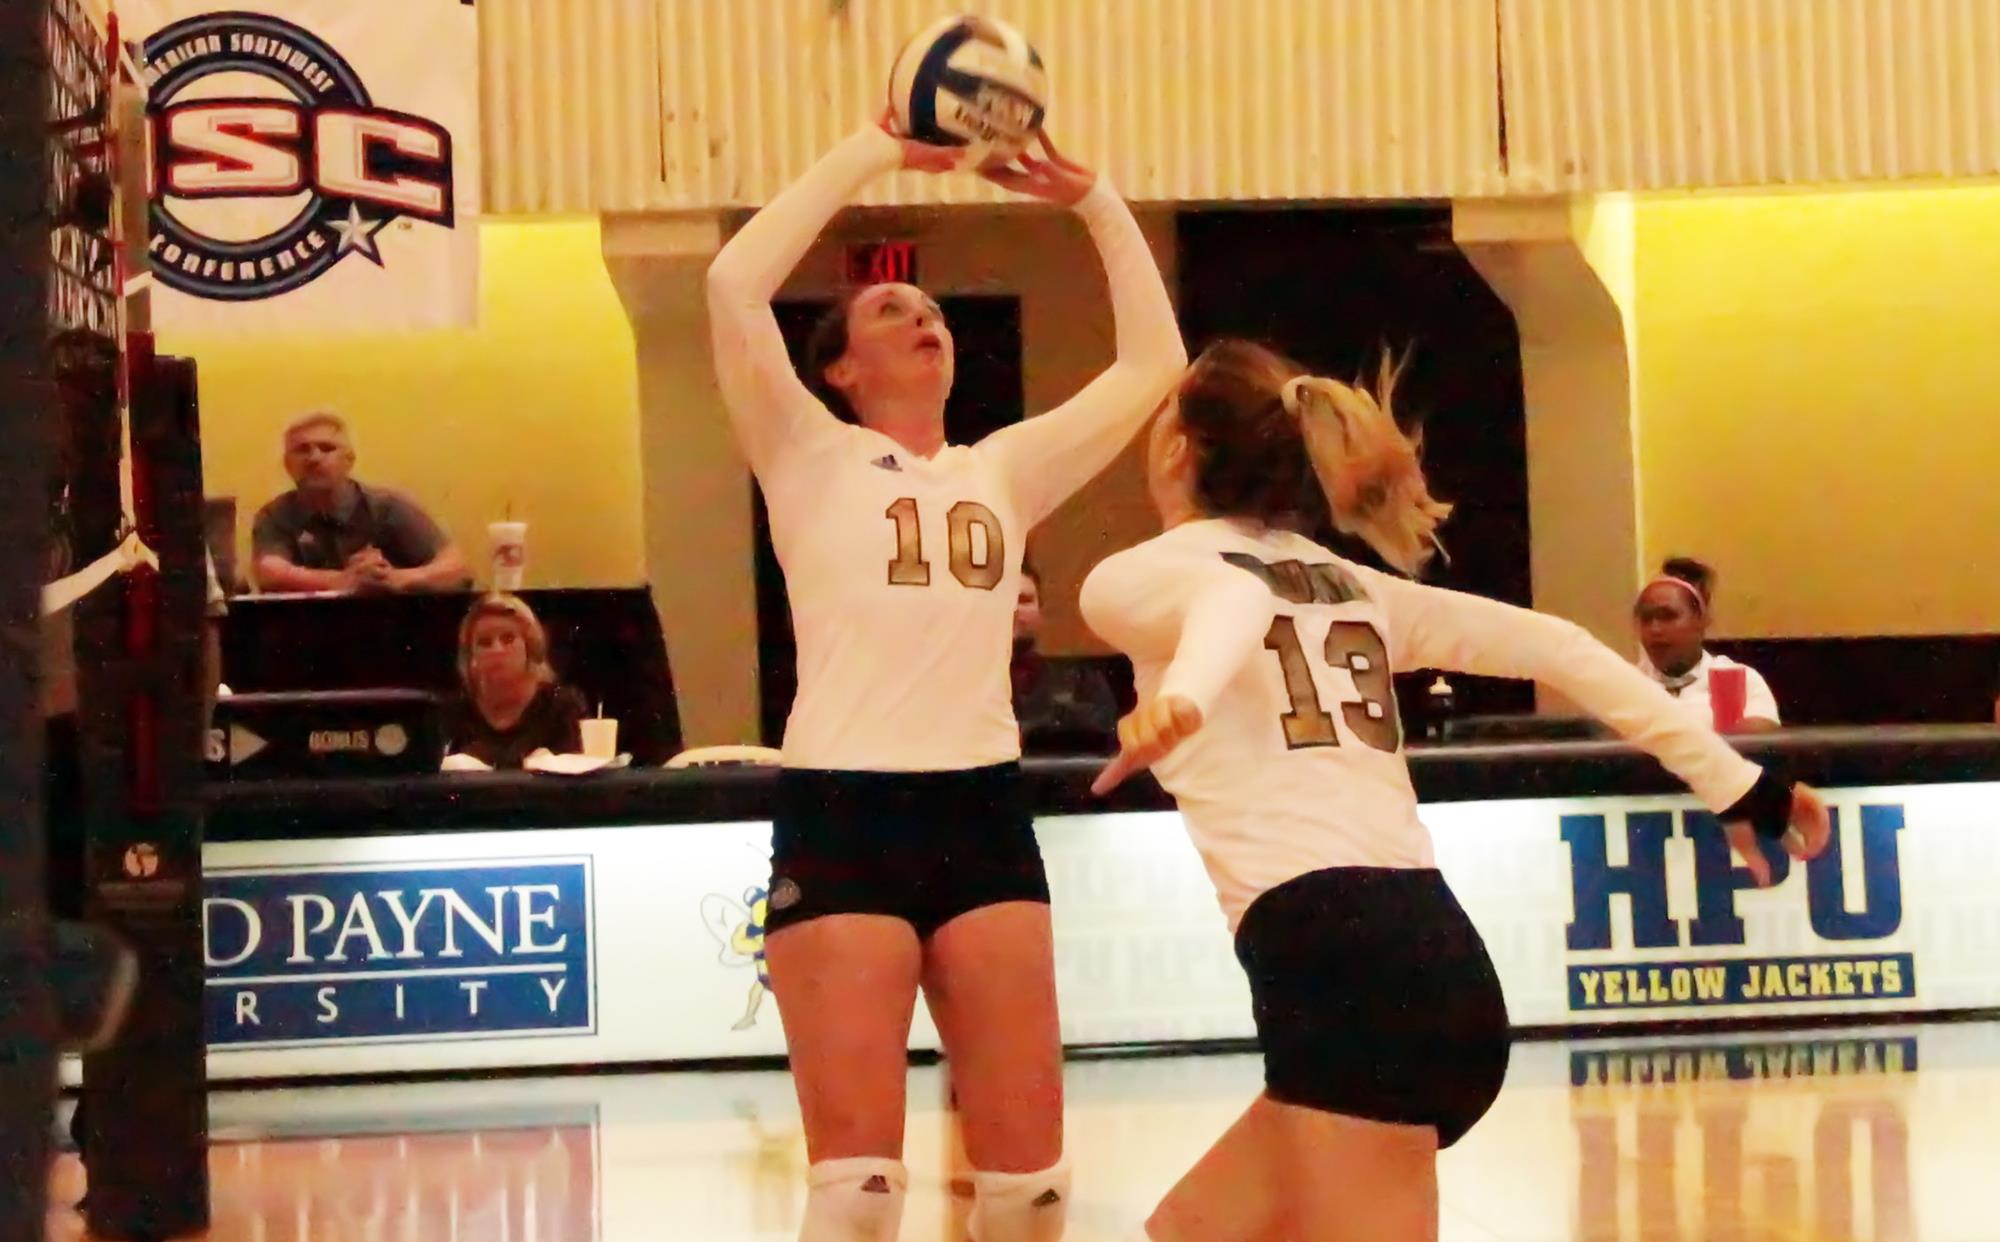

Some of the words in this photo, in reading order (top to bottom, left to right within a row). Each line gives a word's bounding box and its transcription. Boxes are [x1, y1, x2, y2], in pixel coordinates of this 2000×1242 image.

[143, 34, 222, 87] MERICAN
[230, 32, 335, 93] SOUTHWEST
[146, 100, 453, 225] SC
[149, 229, 327, 282] CONFERENCE
[884, 496, 1006, 592] 10
[1264, 613, 1400, 754] 13
[1560, 803, 1905, 950] HPU
[286, 883, 567, 965] PAYNE
[1579, 964, 1726, 1004] YELLOW
[1742, 959, 1903, 999] JACKETS
